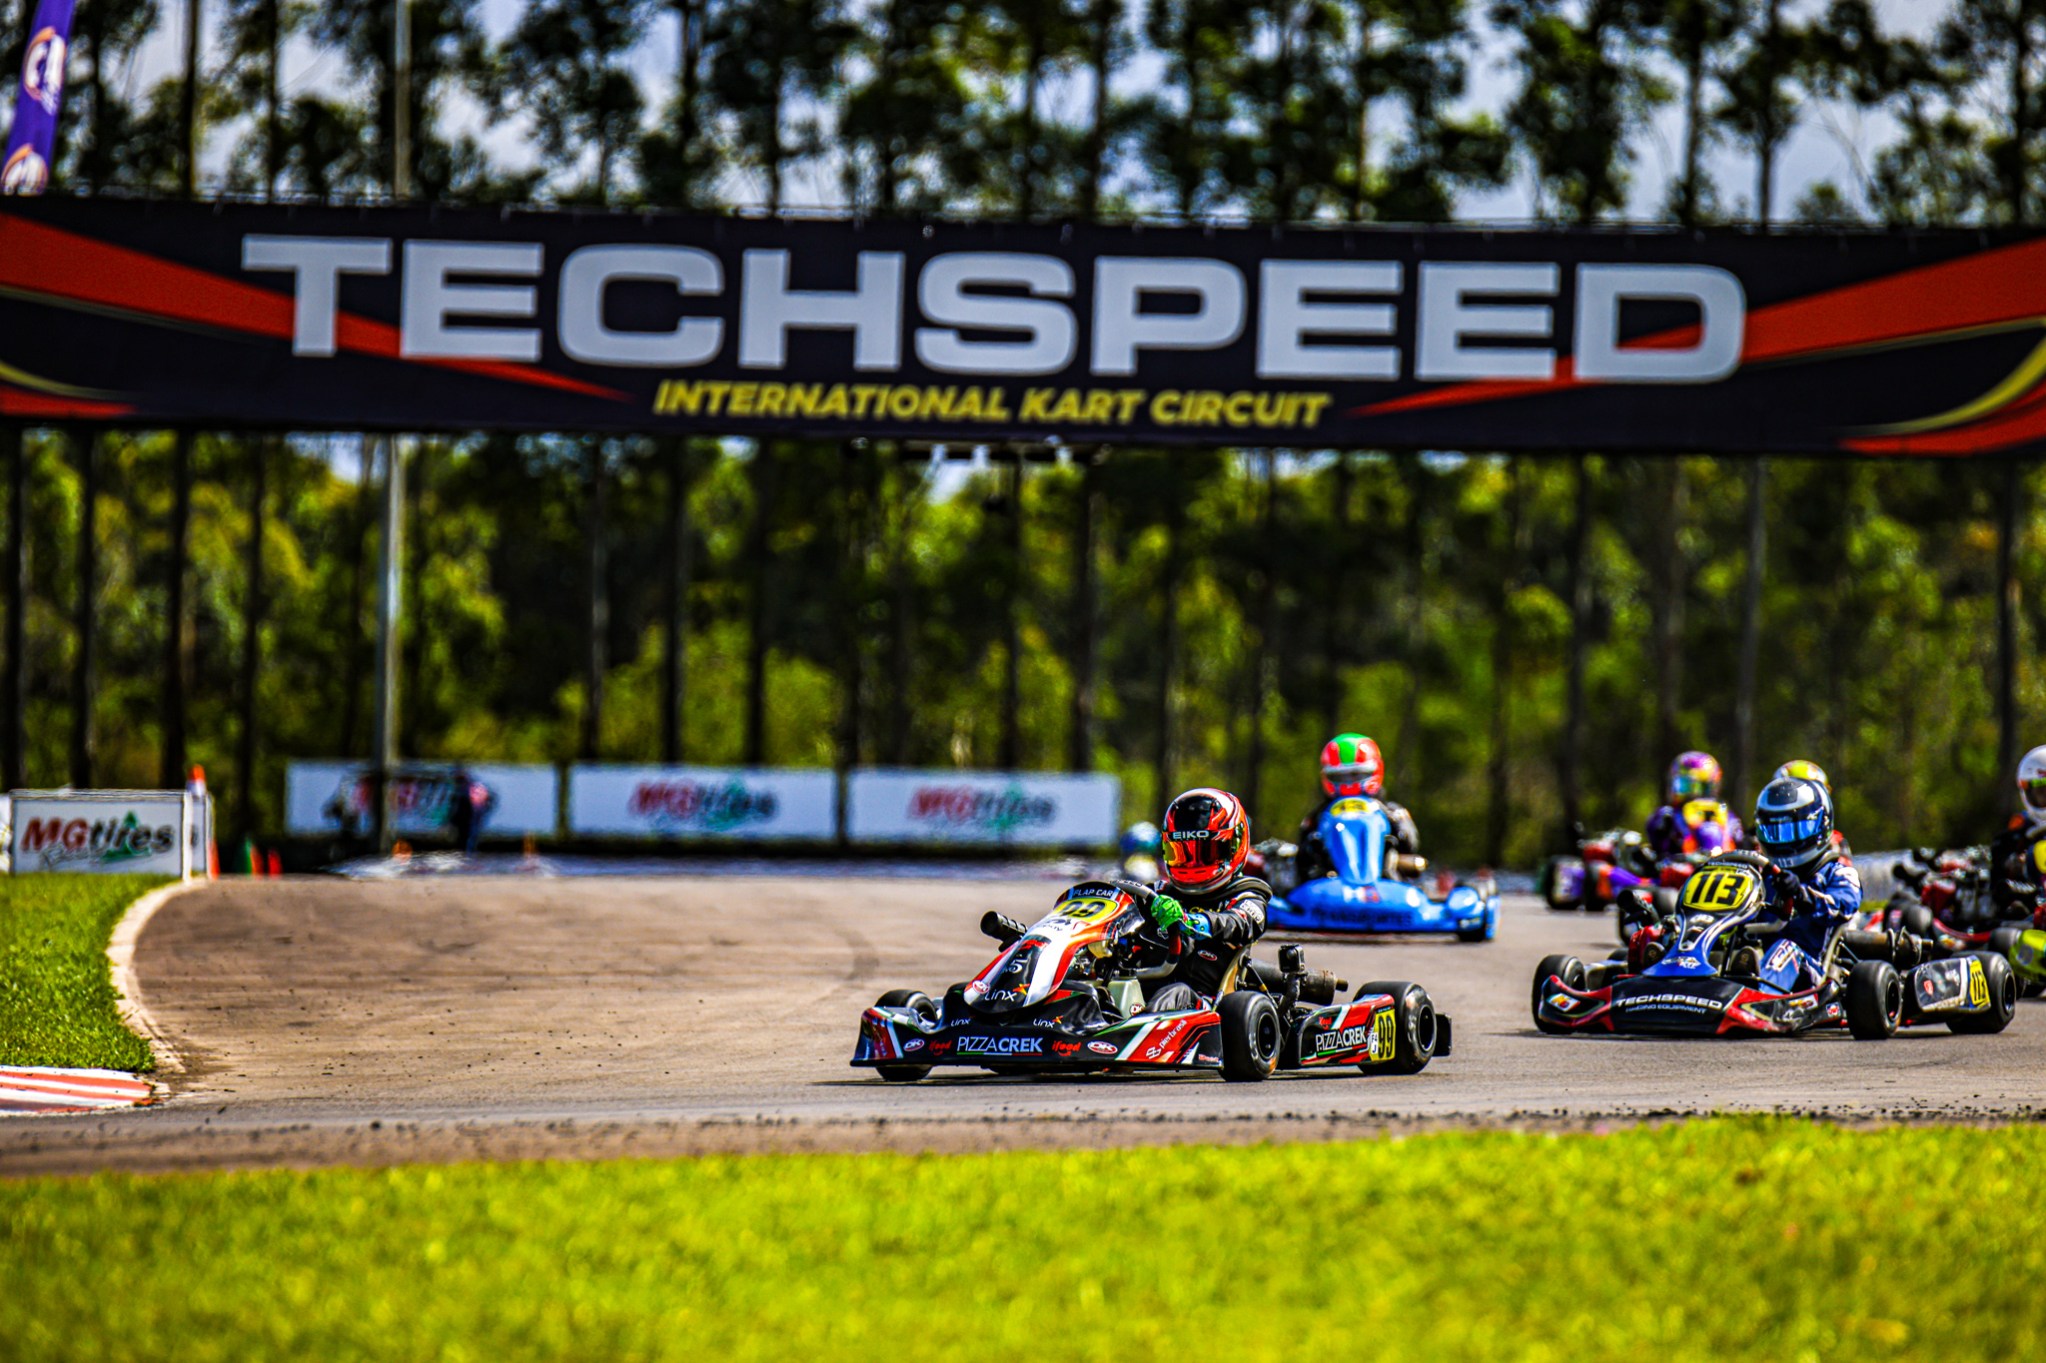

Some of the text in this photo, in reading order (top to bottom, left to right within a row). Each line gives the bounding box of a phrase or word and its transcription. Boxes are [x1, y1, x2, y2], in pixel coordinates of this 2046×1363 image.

[241, 233, 1747, 385] TECHSPEED
[653, 379, 1330, 429] INTERNATIONAL KART CIRCUIT
[20, 811, 177, 853] MGtires
[1172, 830, 1210, 840] EIKO
[1778, 857, 1794, 868] 113
[1095, 888, 1114, 897] CAR
[1690, 873, 1746, 906] 113
[1615, 993, 1723, 1010] TECHSPEED
[1657, 1003, 1708, 1015] EQUIPMENT
[1378, 1015, 1394, 1059] 99
